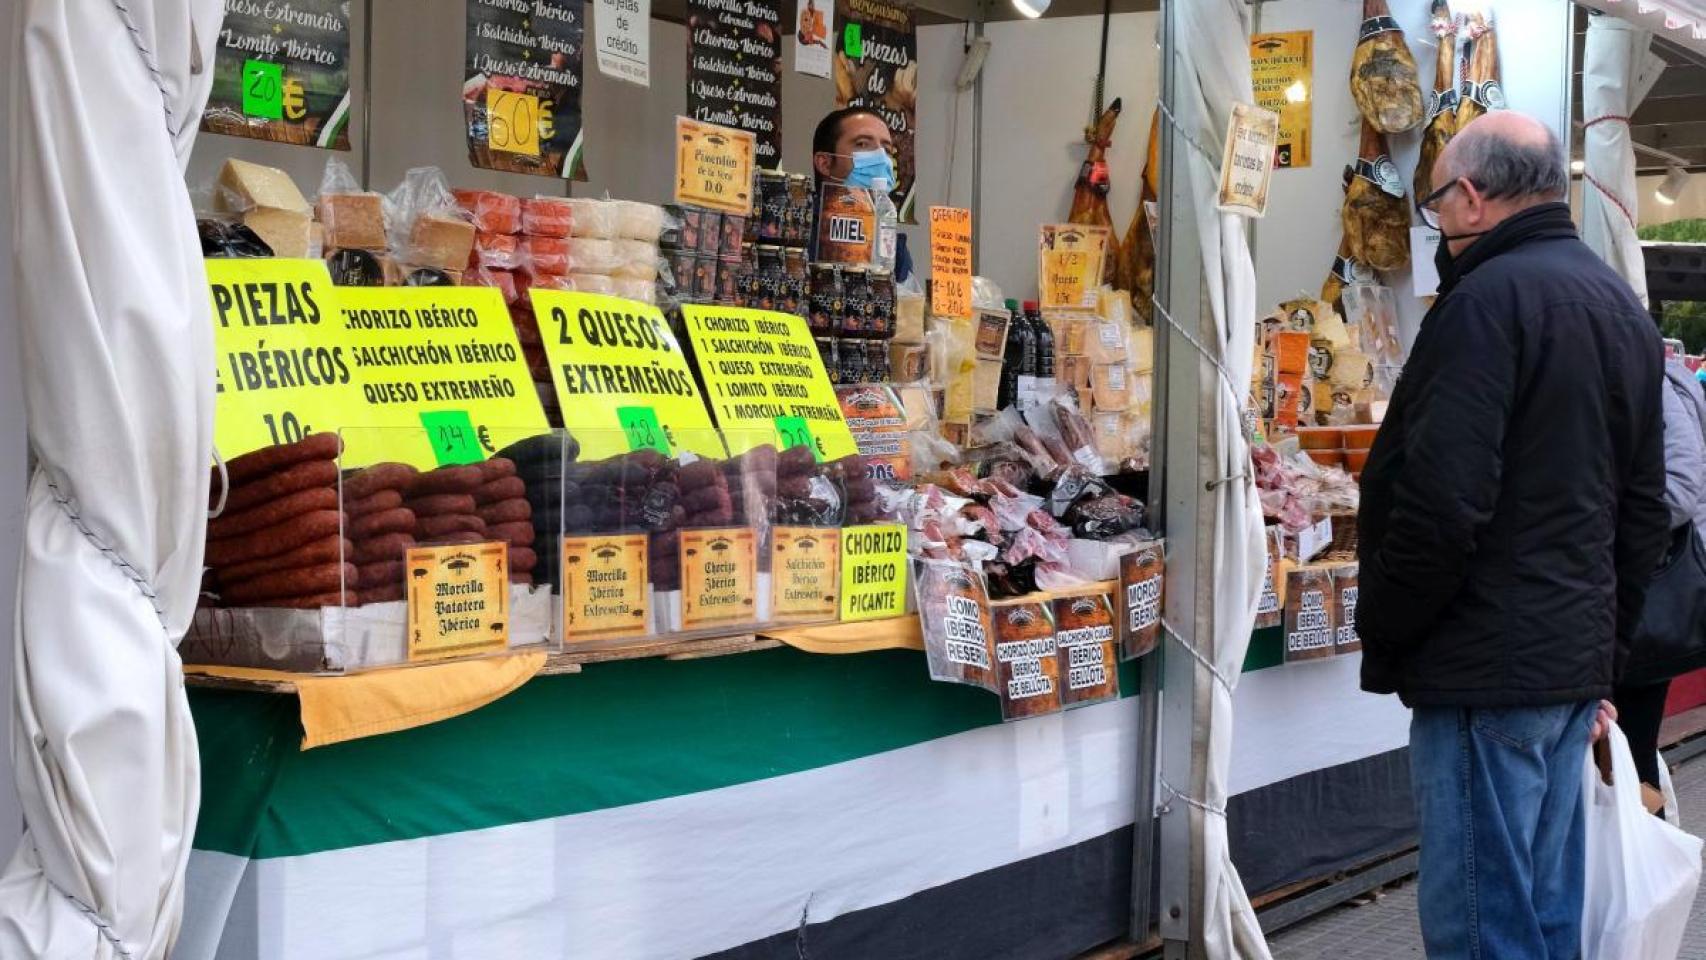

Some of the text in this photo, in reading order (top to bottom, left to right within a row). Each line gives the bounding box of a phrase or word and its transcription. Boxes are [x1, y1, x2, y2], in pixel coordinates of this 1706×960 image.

[263, 1, 342, 31] Extremeño
[616, 15, 629, 31] de
[221, 28, 336, 65] Lomito Ibérico
[482, 22, 536, 47] Salchichón
[538, 34, 575, 54] Ibérico
[606, 35, 638, 55] crédito
[699, 30, 739, 51] Chorizo
[740, 38, 774, 58] Ibérico
[861, 35, 908, 66] piezas
[480, 53, 516, 78] Queso
[516, 60, 578, 87] Extremeño
[744, 65, 776, 83] Ibérico
[868, 67, 887, 94] de
[249, 70, 275, 101] 20
[696, 80, 725, 99] Queso
[726, 83, 777, 108] Extremeño
[490, 94, 531, 147] 60
[700, 106, 739, 126] Lomito
[739, 113, 774, 131] Ibérico
[831, 218, 865, 241] MIEL
[211, 282, 320, 327] PIEZAS
[415, 303, 478, 328] IBÉRICO
[551, 307, 671, 352] 2 QUESOS
[694, 316, 790, 337] 1 CHORIZO IBÉRICO
[455, 338, 517, 363] IBÉRICO
[701, 337, 812, 359] 1 SALCHICHÓN IBÉRICO
[228, 340, 350, 391] IBÉRICOS
[708, 360, 814, 379] 1 QUESO EXTREMEÑO
[363, 375, 516, 404] QUESO EXTREMEÑO
[562, 360, 693, 397] EXTREMEÑOS
[716, 380, 809, 398] 1 LOMITO IBÉRICO
[723, 404, 842, 421] 1 MORCILLA EXTREMEÑA
[846, 531, 902, 555] CHORIZO
[586, 568, 628, 583] Morcilla
[705, 561, 736, 575] Chorizo
[853, 561, 895, 584] IBÉRICO
[435, 580, 484, 597] Morcilla
[435, 600, 485, 616] Patatera
[584, 602, 629, 616] Extremeña
[850, 591, 895, 613] PICANTE
[948, 598, 978, 618] LOMO
[1302, 593, 1322, 607] LOMO
[1095, 626, 1112, 639] CULAR
[1290, 635, 1301, 648] DE
[998, 640, 1054, 659] CHORIZO CULAR
[1010, 677, 1050, 696] DE BELLOTA
[1071, 667, 1105, 687] BELLOTA
